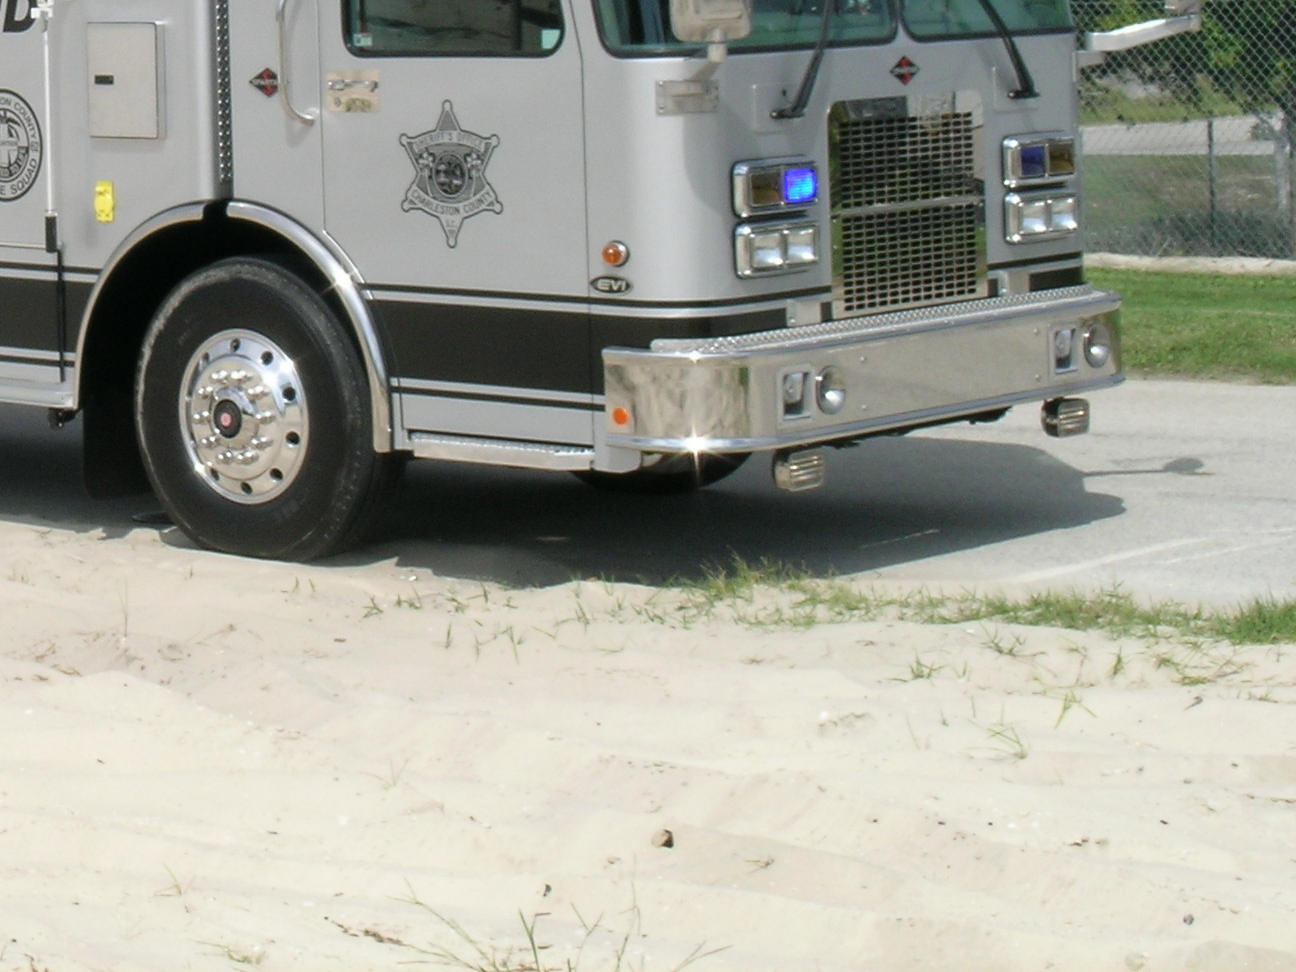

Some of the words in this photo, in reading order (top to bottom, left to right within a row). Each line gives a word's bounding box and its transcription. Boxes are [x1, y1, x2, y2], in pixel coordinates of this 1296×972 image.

[14, 102, 37, 140] COUNTY
[10, 158, 37, 196] SQUAD
[411, 190, 461, 215] CHARLESTON
[464, 190, 494, 213] COUNTY
[597, 278, 627, 291] EVI
